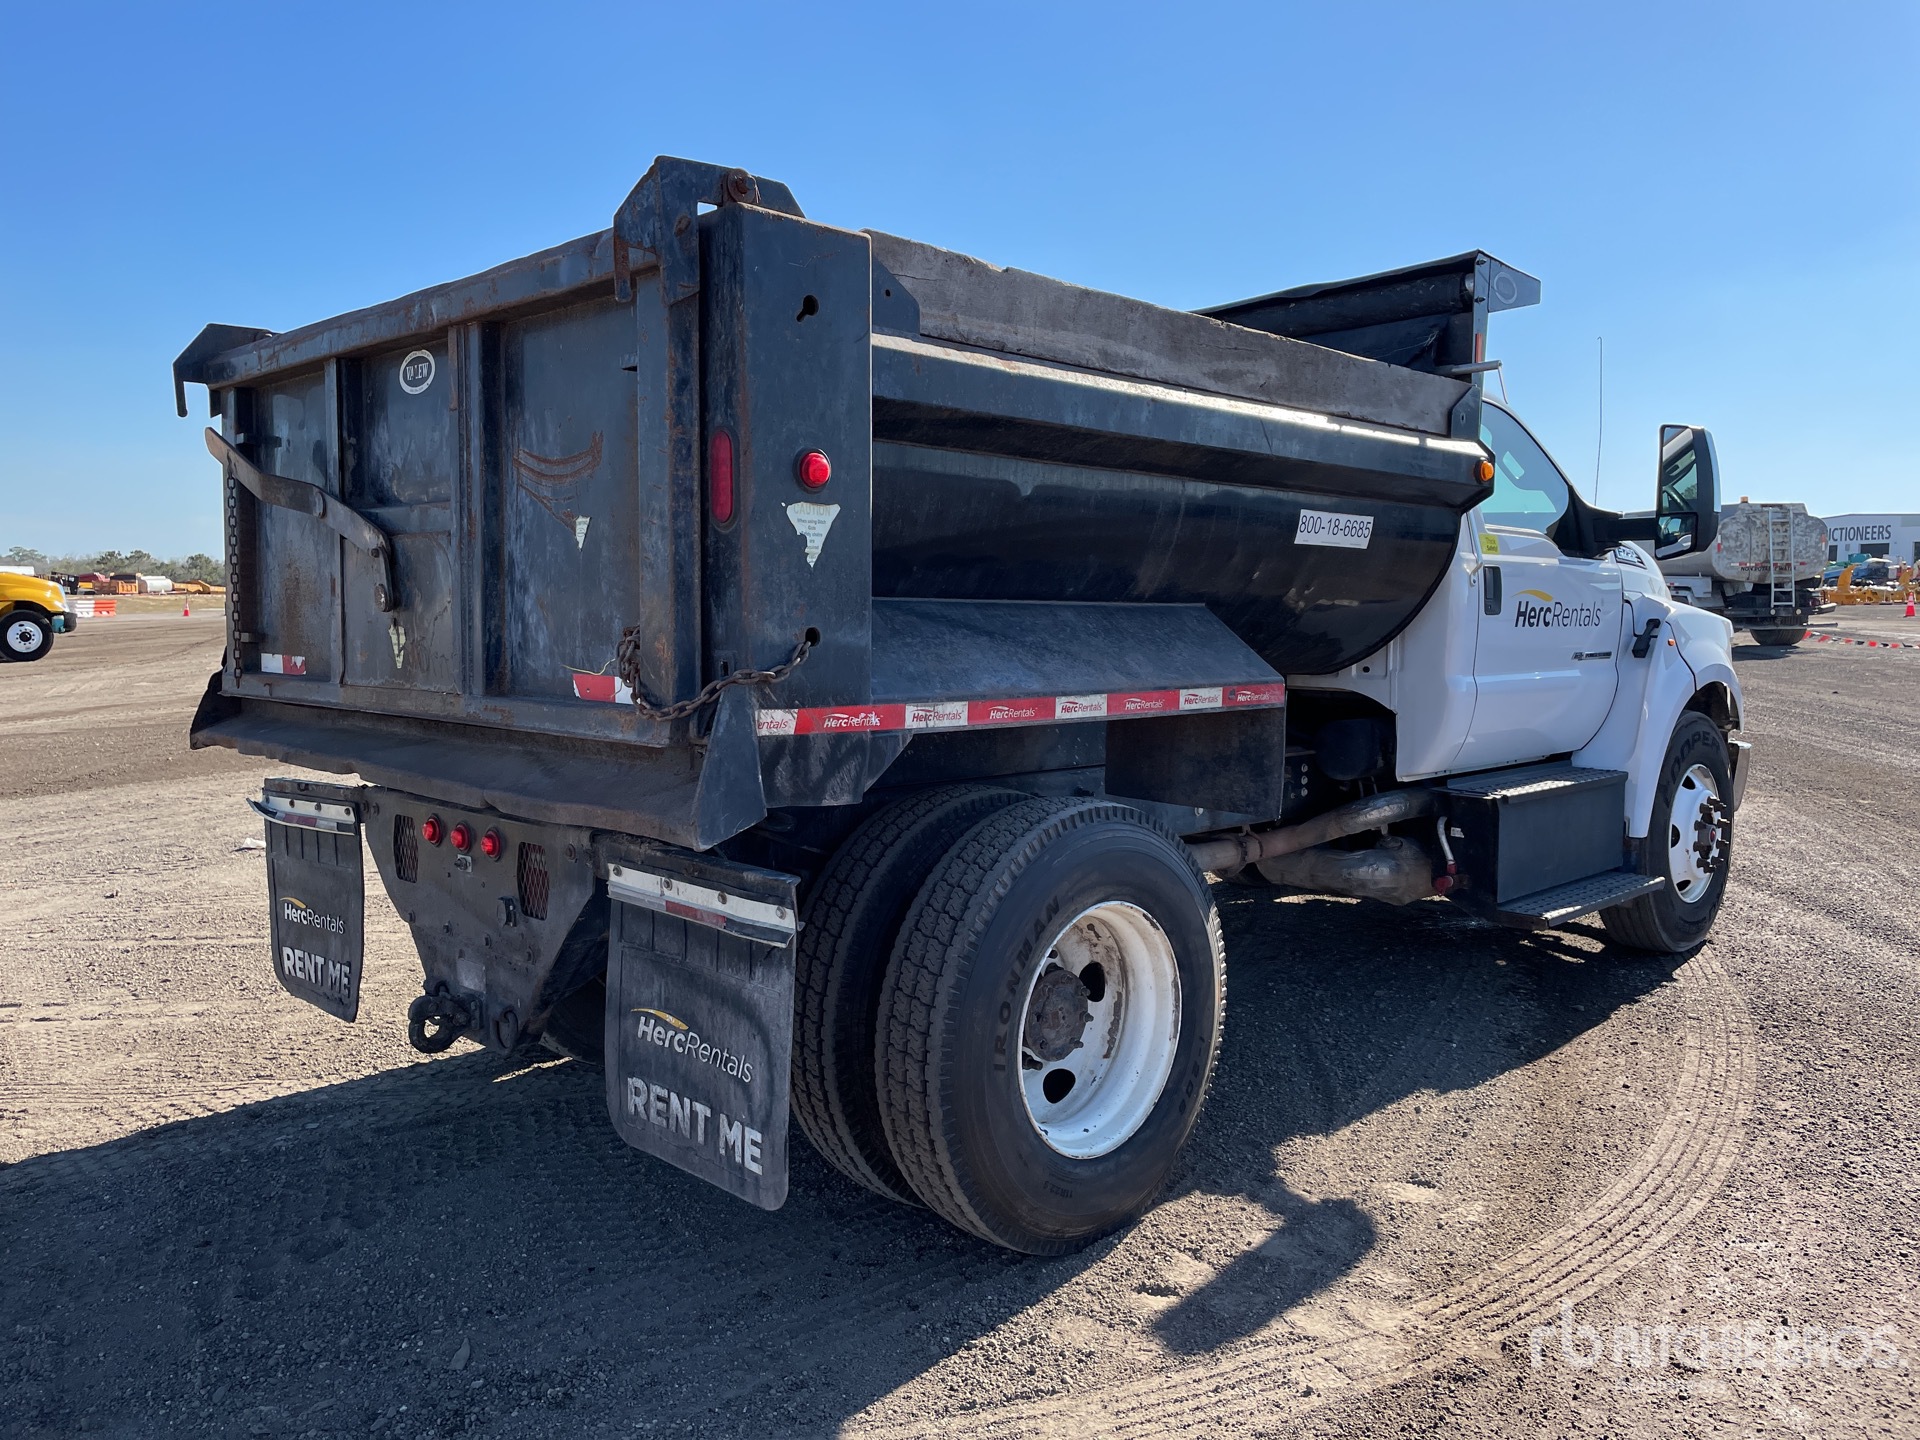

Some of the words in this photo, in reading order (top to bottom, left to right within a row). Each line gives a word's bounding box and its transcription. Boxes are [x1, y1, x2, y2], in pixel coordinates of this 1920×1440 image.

[793, 503, 831, 516] CAUTION
[1299, 514, 1372, 539] 800-18-6685
[1514, 600, 1602, 628] HercRentals
[823, 713, 881, 729] HercRentals
[911, 709, 963, 723] HercRentals
[989, 705, 1036, 720] HercRentals
[1060, 702, 1102, 714] HercRentals
[1125, 699, 1163, 711] HercRentals
[1184, 693, 1219, 705] HercRentals
[1236, 690, 1270, 702] HercRentals
[284, 902, 344, 935] HercRentals
[282, 946, 325, 987] RENT
[328, 960, 351, 999] ME
[992, 895, 1061, 1072] IRONMAN
[637, 1016, 753, 1083] HercRentals
[627, 1077, 711, 1146] RENT
[719, 1113, 763, 1176] ME
